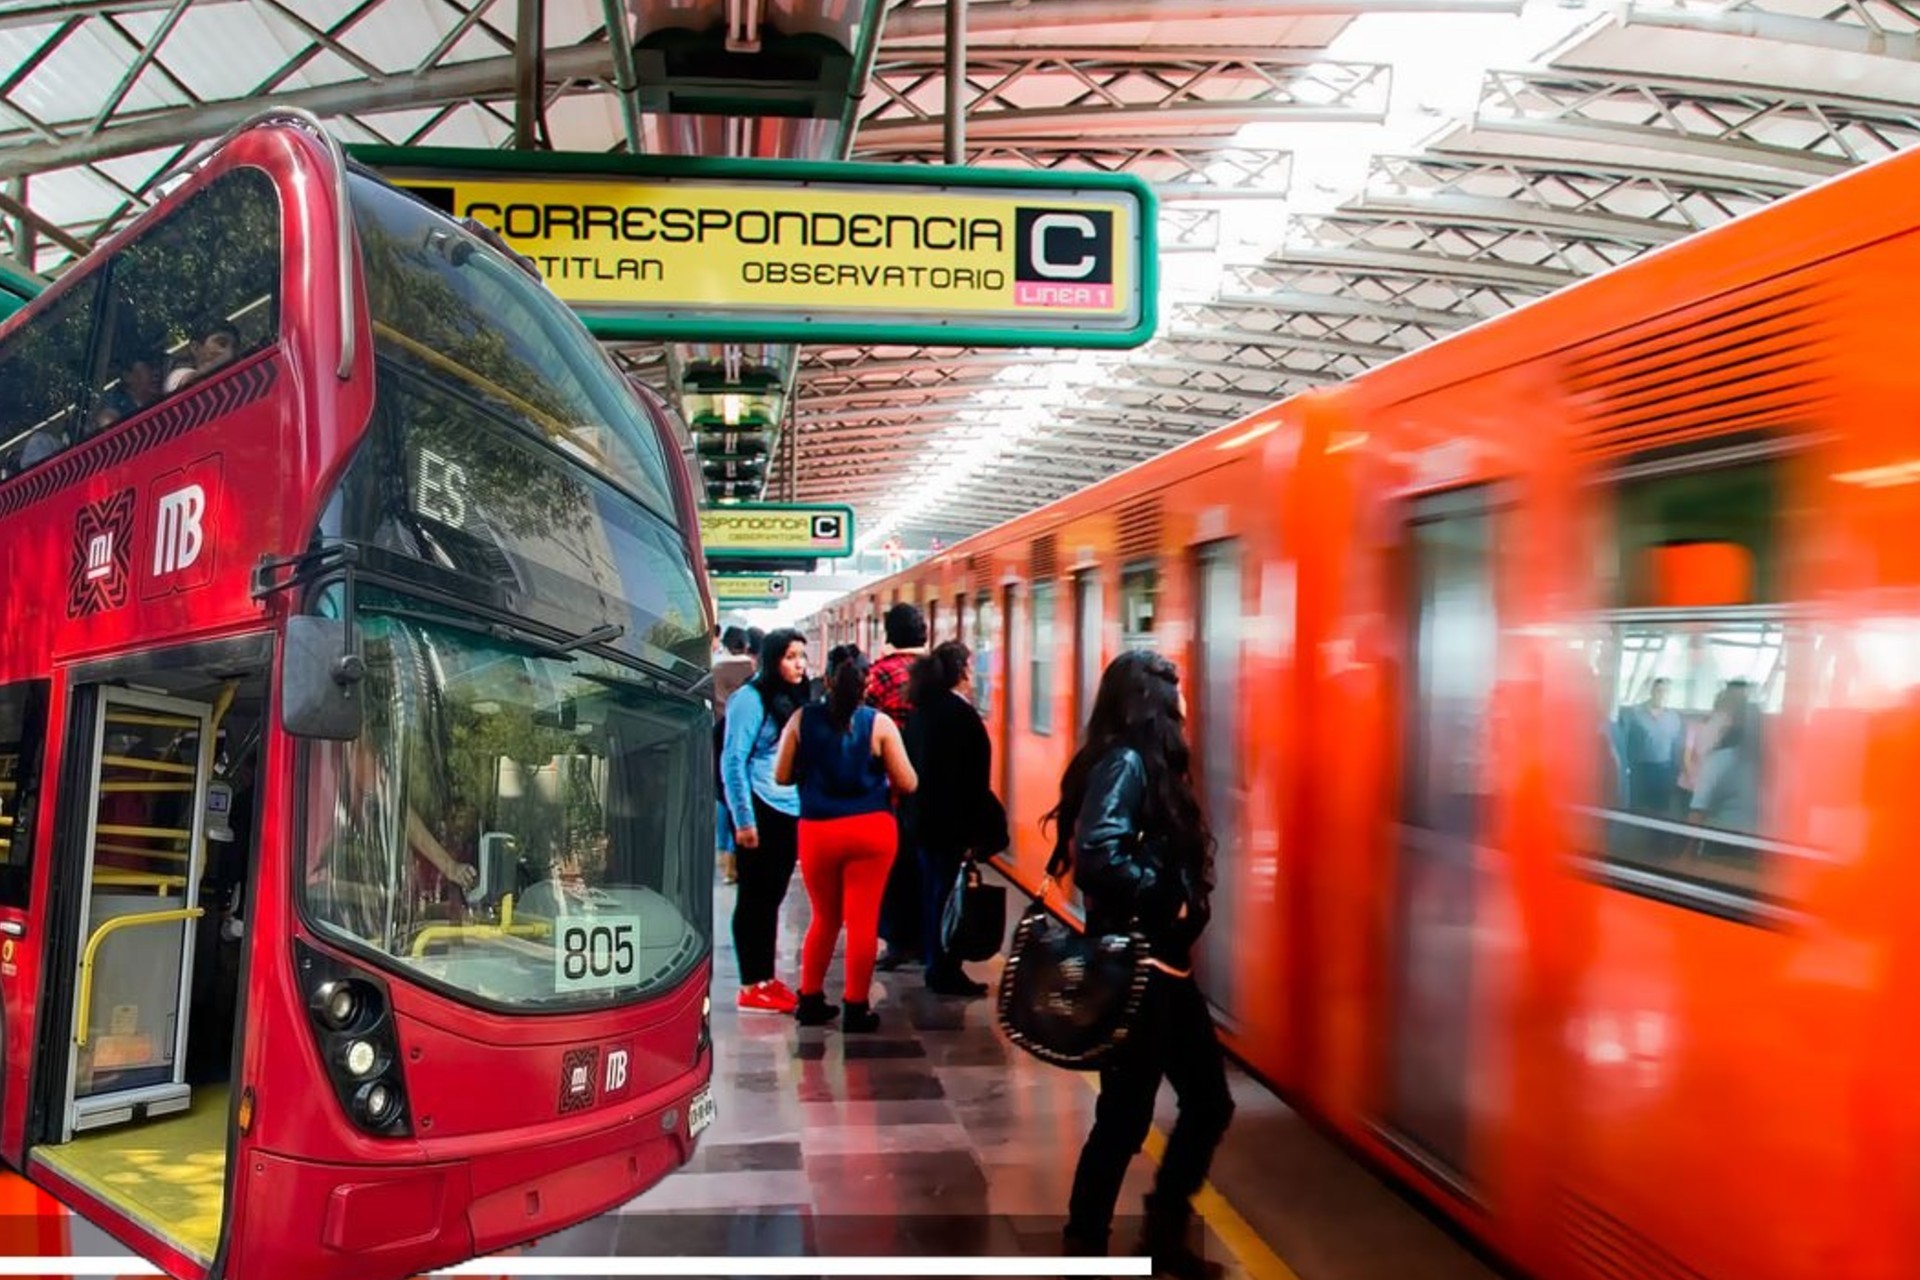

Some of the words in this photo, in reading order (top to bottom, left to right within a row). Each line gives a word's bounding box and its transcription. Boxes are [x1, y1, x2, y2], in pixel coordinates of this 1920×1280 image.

[466, 203, 1003, 252] CORRESPONDENCIA
[1031, 213, 1096, 278] C
[532, 256, 664, 280] TITLAN
[742, 261, 1004, 290] OBSERVATORIO
[1020, 287, 1091, 304] LINEA
[1097, 289, 1109, 305] 1
[417, 447, 467, 529] ES
[154, 484, 205, 575] MB
[815, 517, 837, 537] C
[564, 925, 633, 980] 805
[605, 1050, 627, 1091] MB
